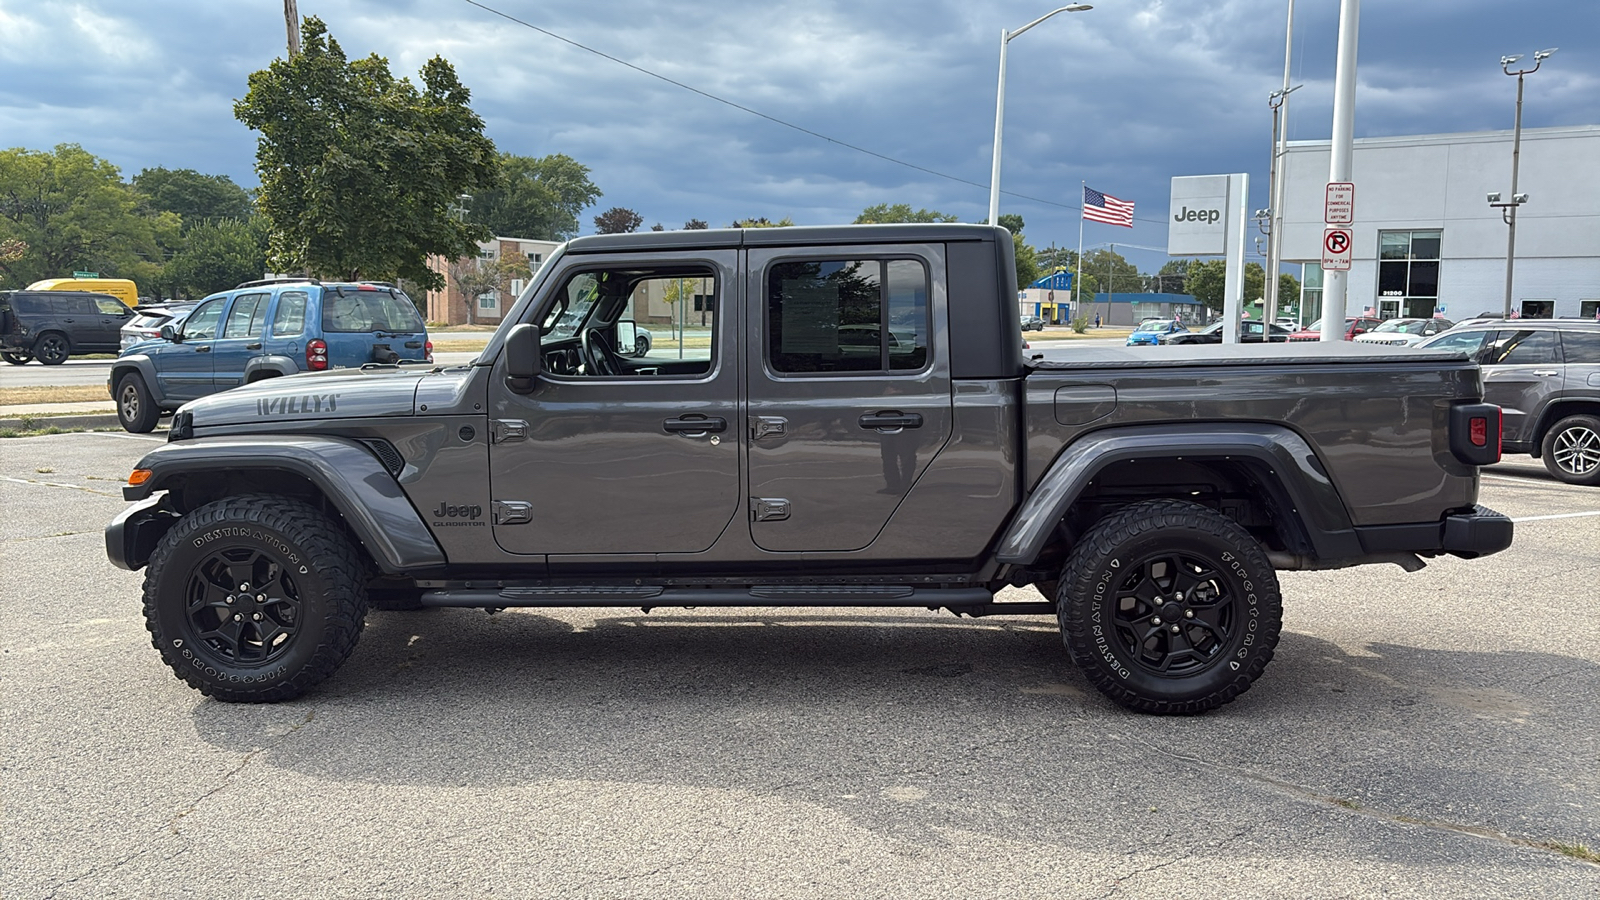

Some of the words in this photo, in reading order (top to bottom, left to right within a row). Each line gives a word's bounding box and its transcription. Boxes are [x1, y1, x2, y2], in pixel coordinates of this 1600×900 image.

[1174, 206, 1220, 225] Jeep
[256, 393, 341, 416] WILLYS
[433, 500, 482, 520] Jeep
[192, 526, 300, 565] DESTINATION
[1220, 551, 1260, 660] Firestone
[1091, 569, 1131, 680] DESTINATION
[182, 648, 287, 684] Firestone
